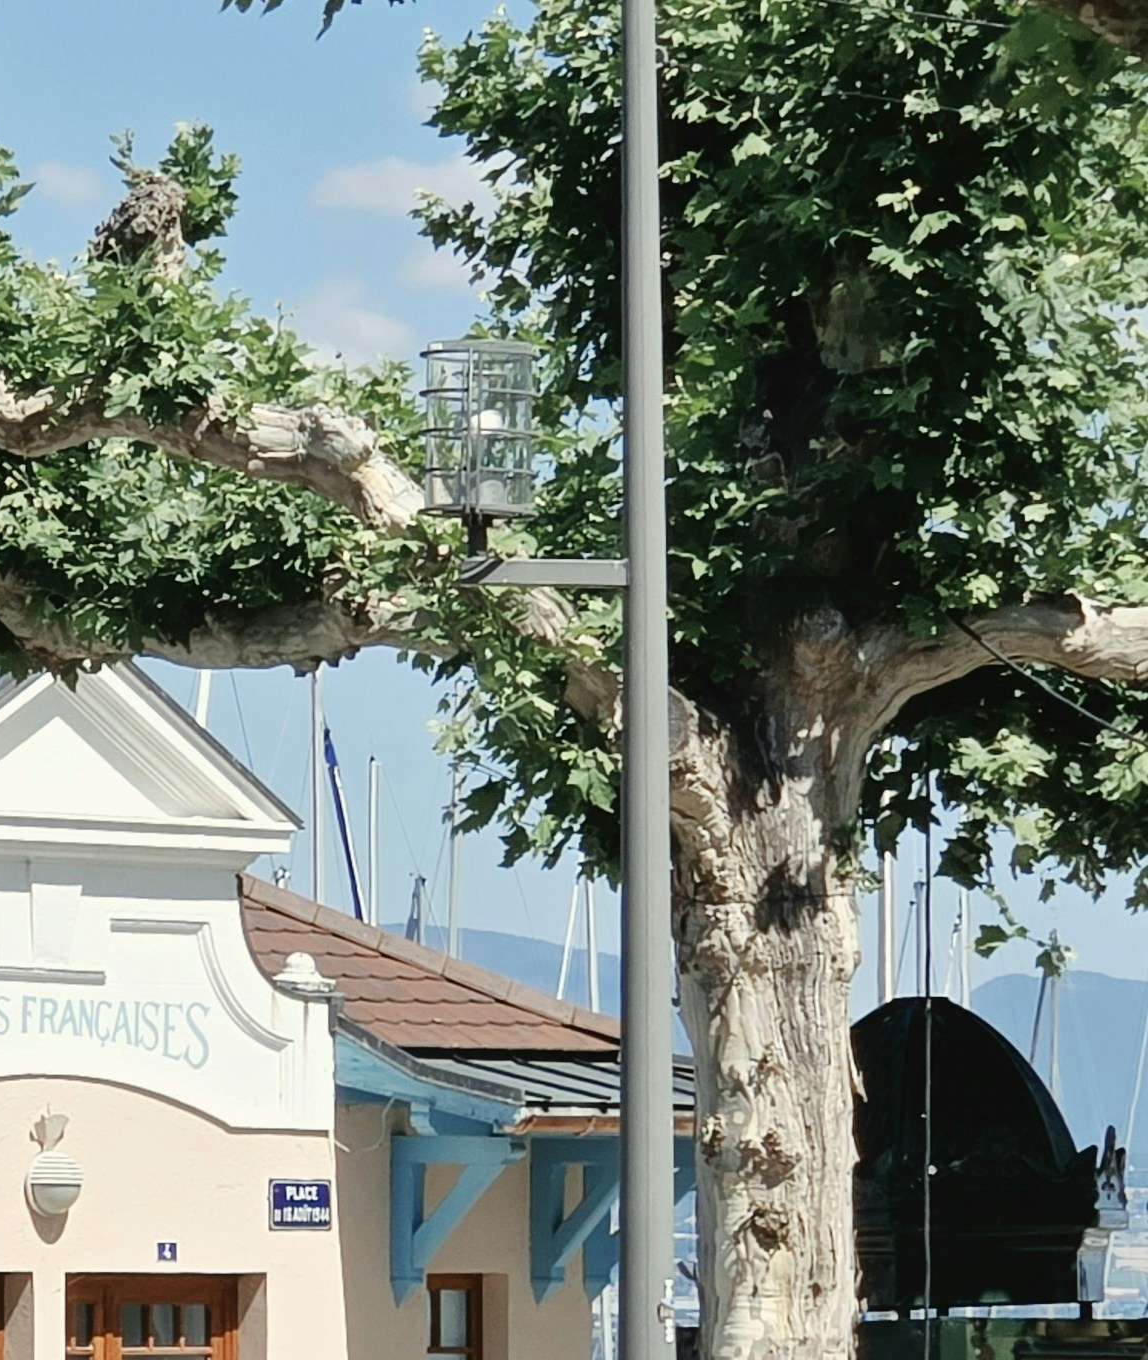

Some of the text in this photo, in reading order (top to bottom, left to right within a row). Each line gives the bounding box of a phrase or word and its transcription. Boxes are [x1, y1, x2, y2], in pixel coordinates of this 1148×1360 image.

[20, 994, 211, 1070] FRANÇAISES
[285, 1185, 318, 1201] PLACE
[162, 1243, 172, 1259] 4
